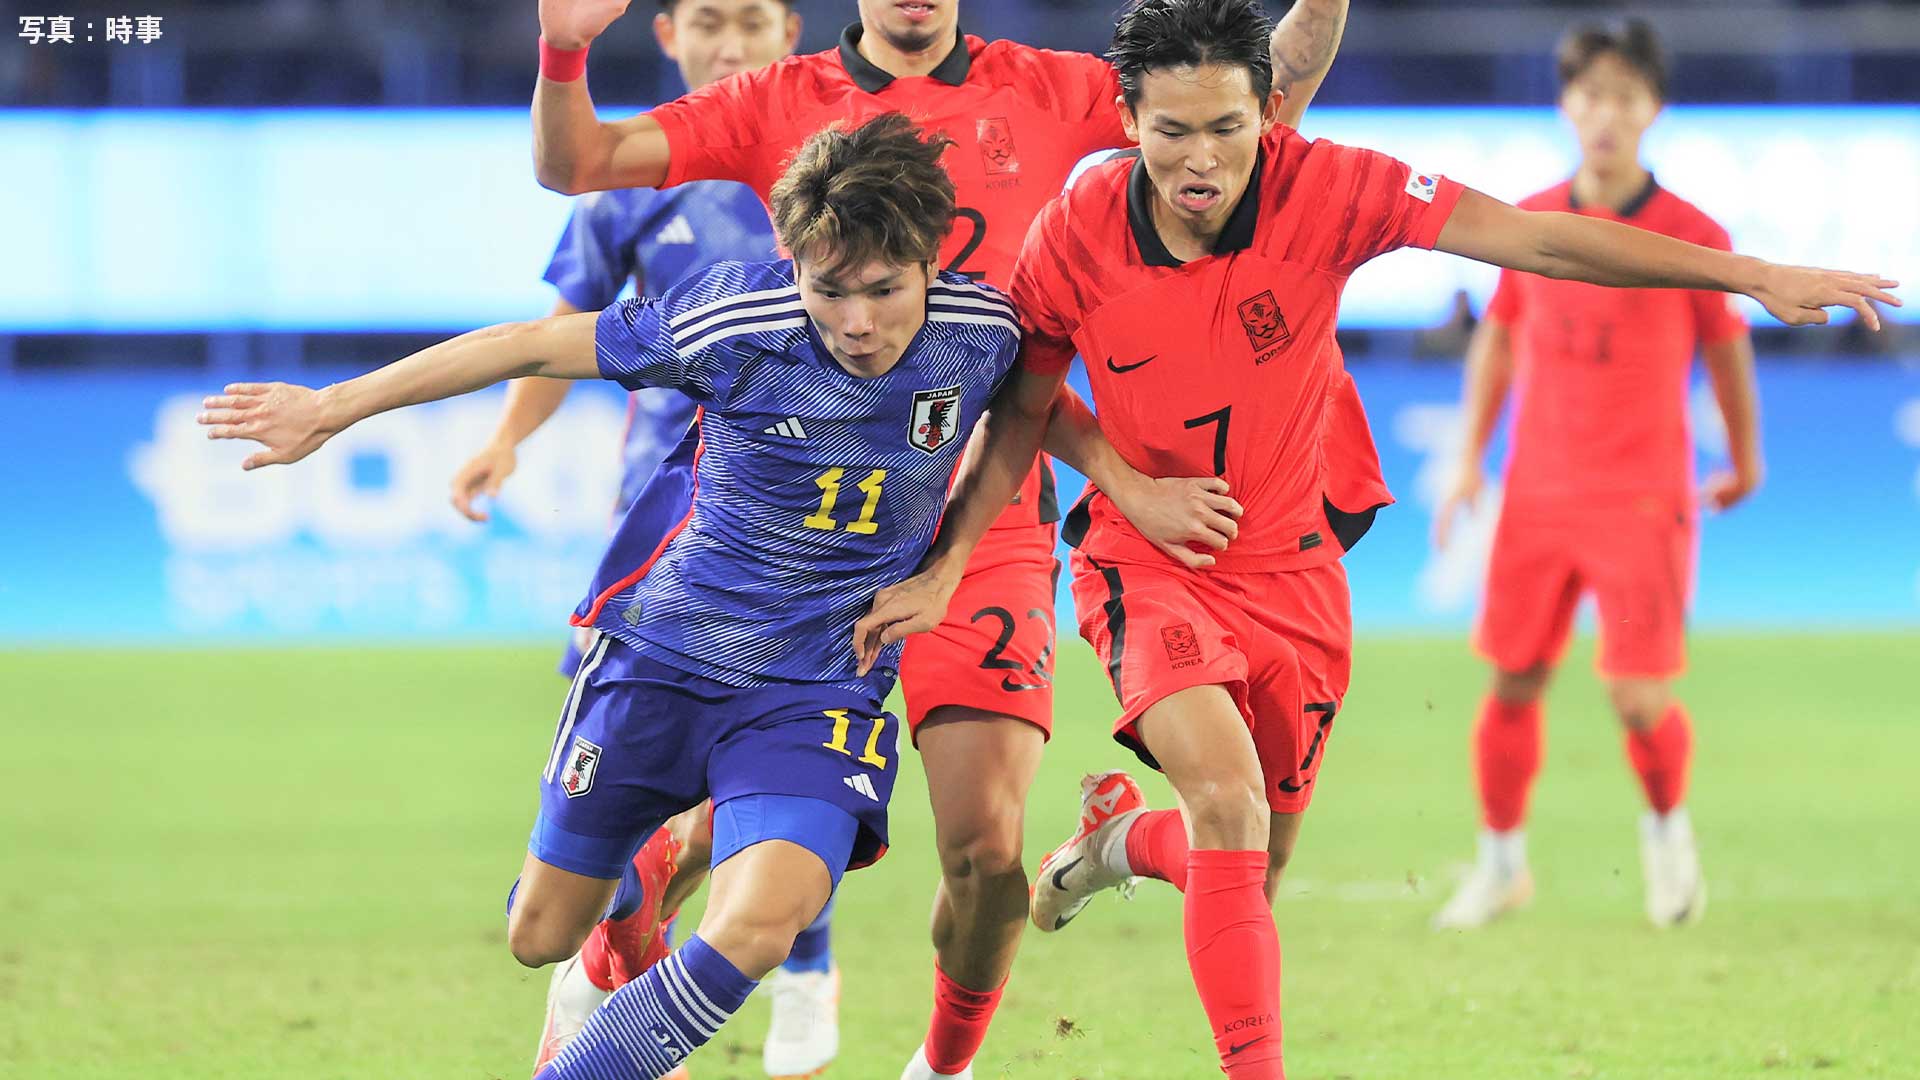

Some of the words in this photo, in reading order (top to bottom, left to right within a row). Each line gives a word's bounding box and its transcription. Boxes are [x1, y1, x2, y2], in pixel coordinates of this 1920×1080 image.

[926, 390, 953, 400] JAPAN
[1184, 405, 1232, 476] 7
[803, 467, 887, 535] 11
[1171, 658, 1204, 670] KOREA
[822, 707, 888, 771] 11
[1299, 701, 1337, 771] 7
[1224, 1013, 1274, 1034] KOREA
